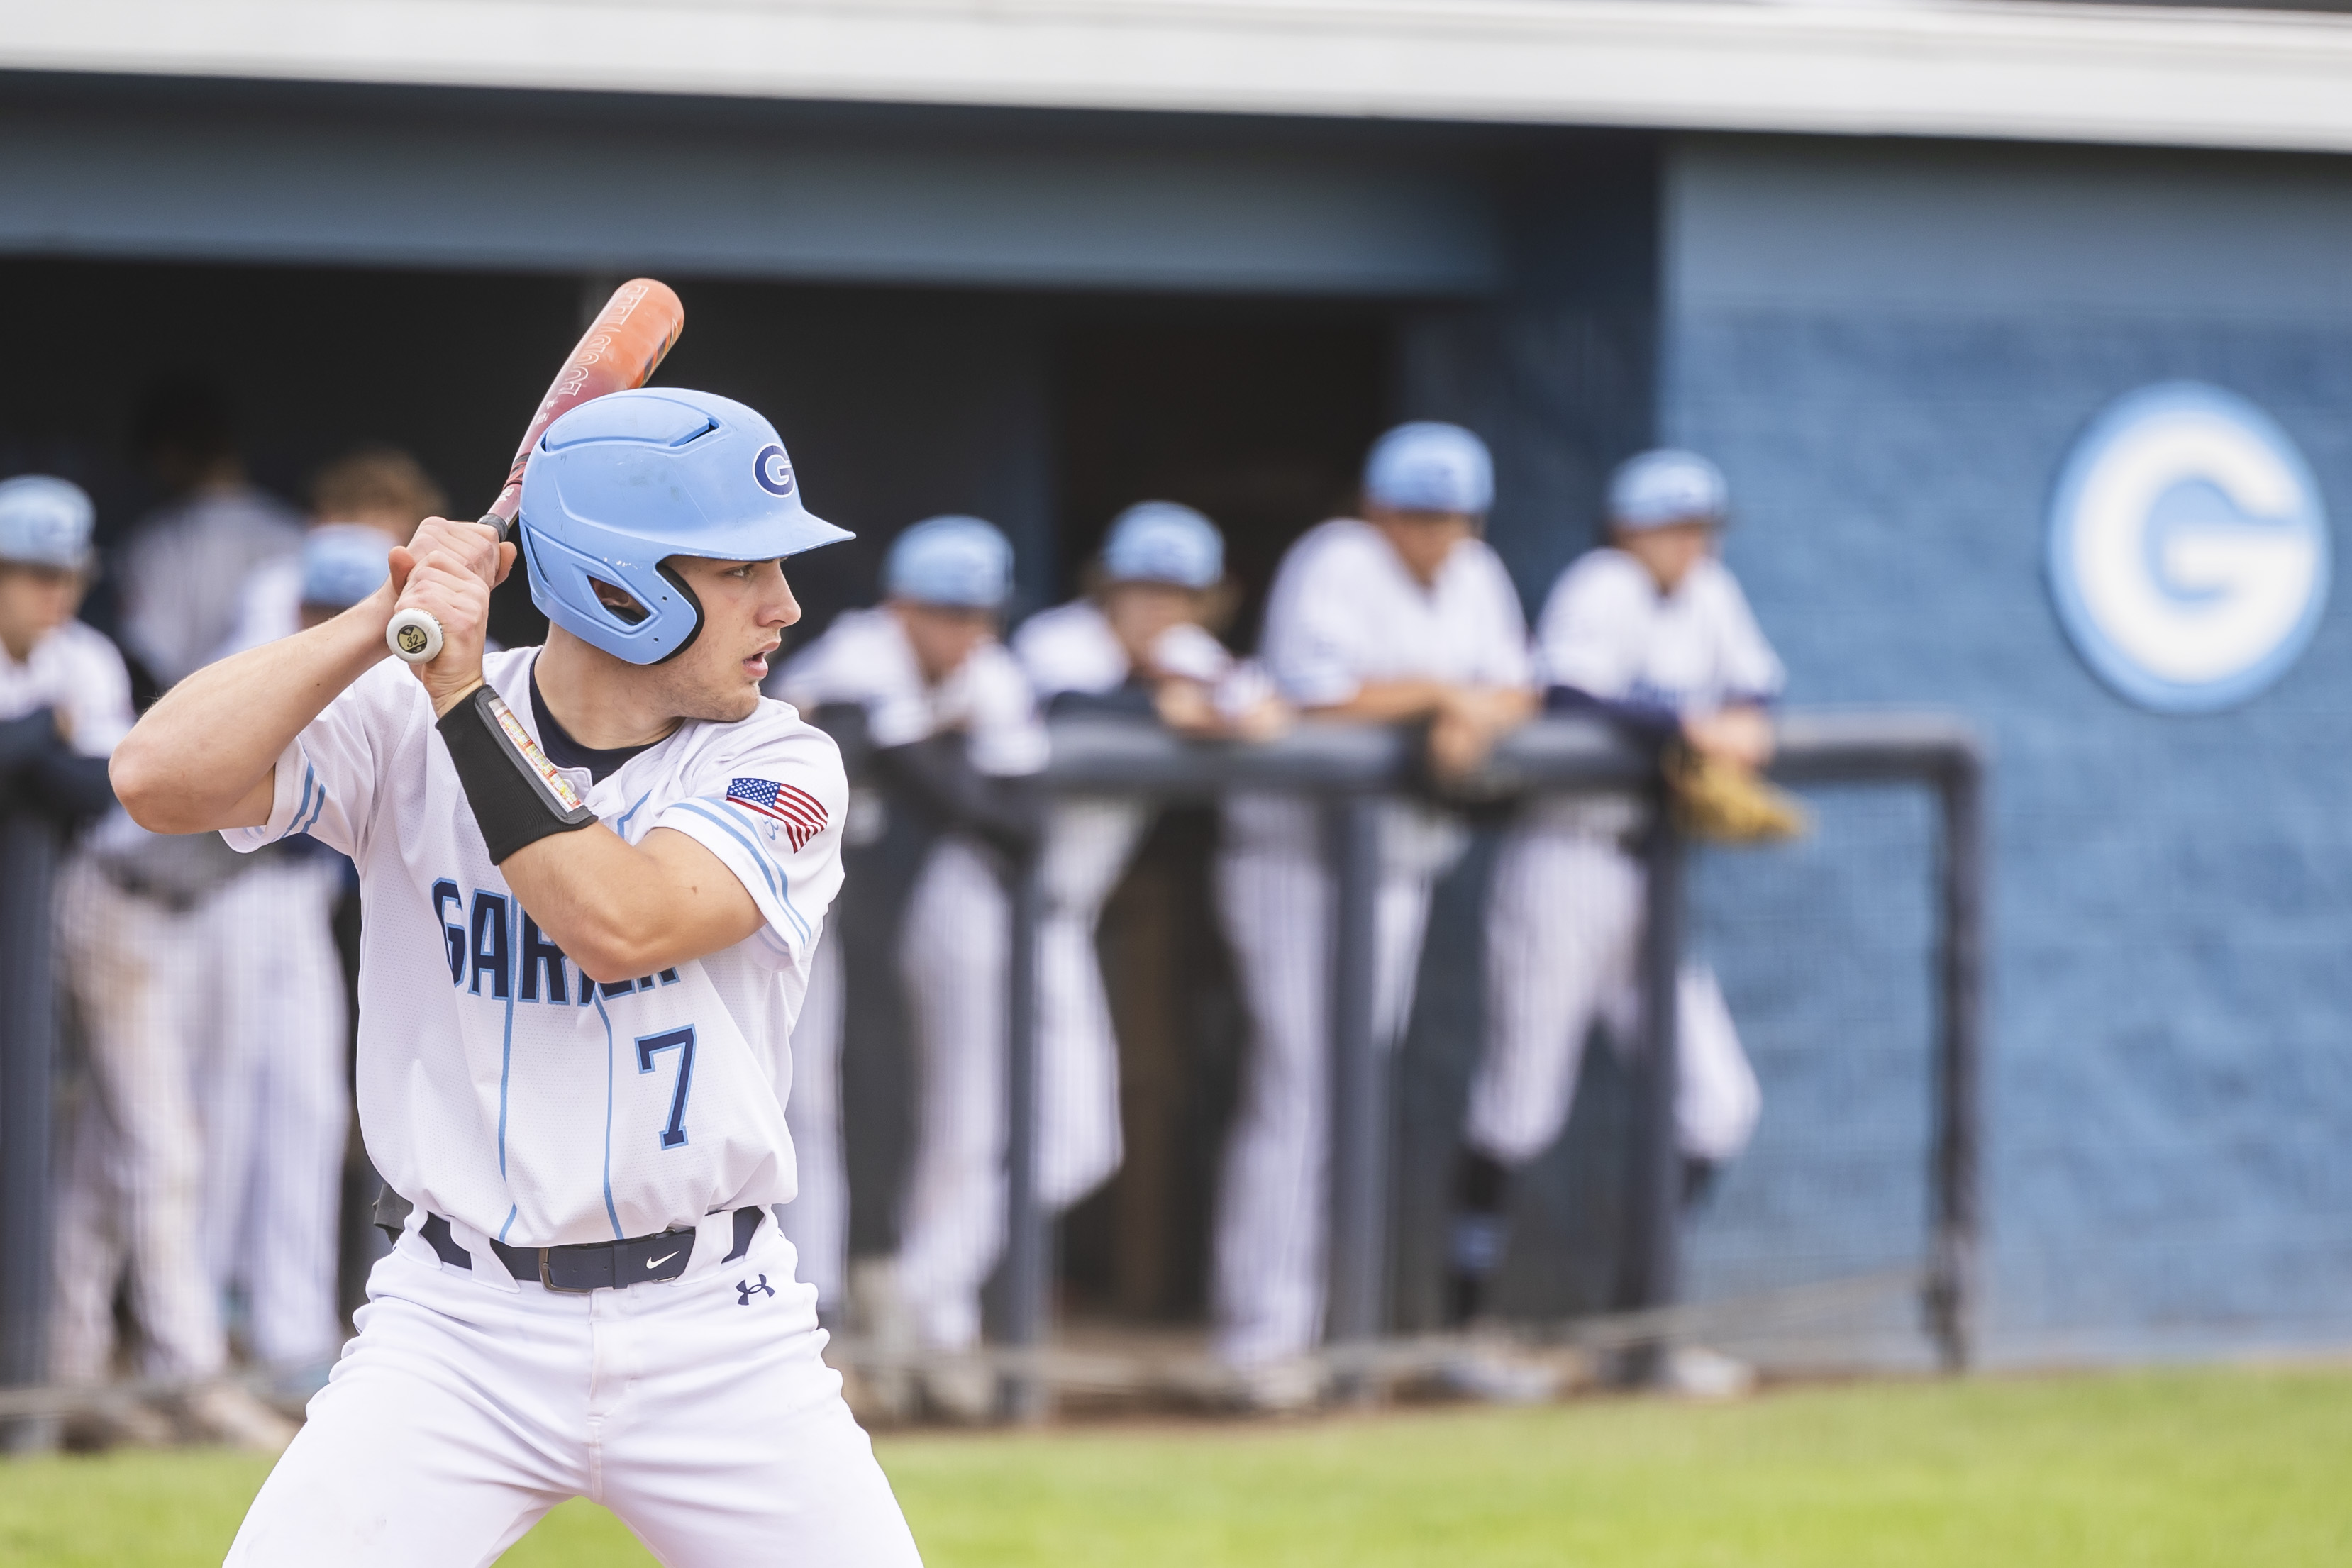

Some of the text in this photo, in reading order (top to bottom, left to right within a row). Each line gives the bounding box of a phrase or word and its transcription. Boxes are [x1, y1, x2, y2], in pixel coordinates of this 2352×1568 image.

[752, 443, 796, 498] G
[2071, 408, 2317, 683] G
[406, 634, 418, 647] 32
[431, 877, 681, 1008] GAR
[634, 1023, 697, 1150] 7
